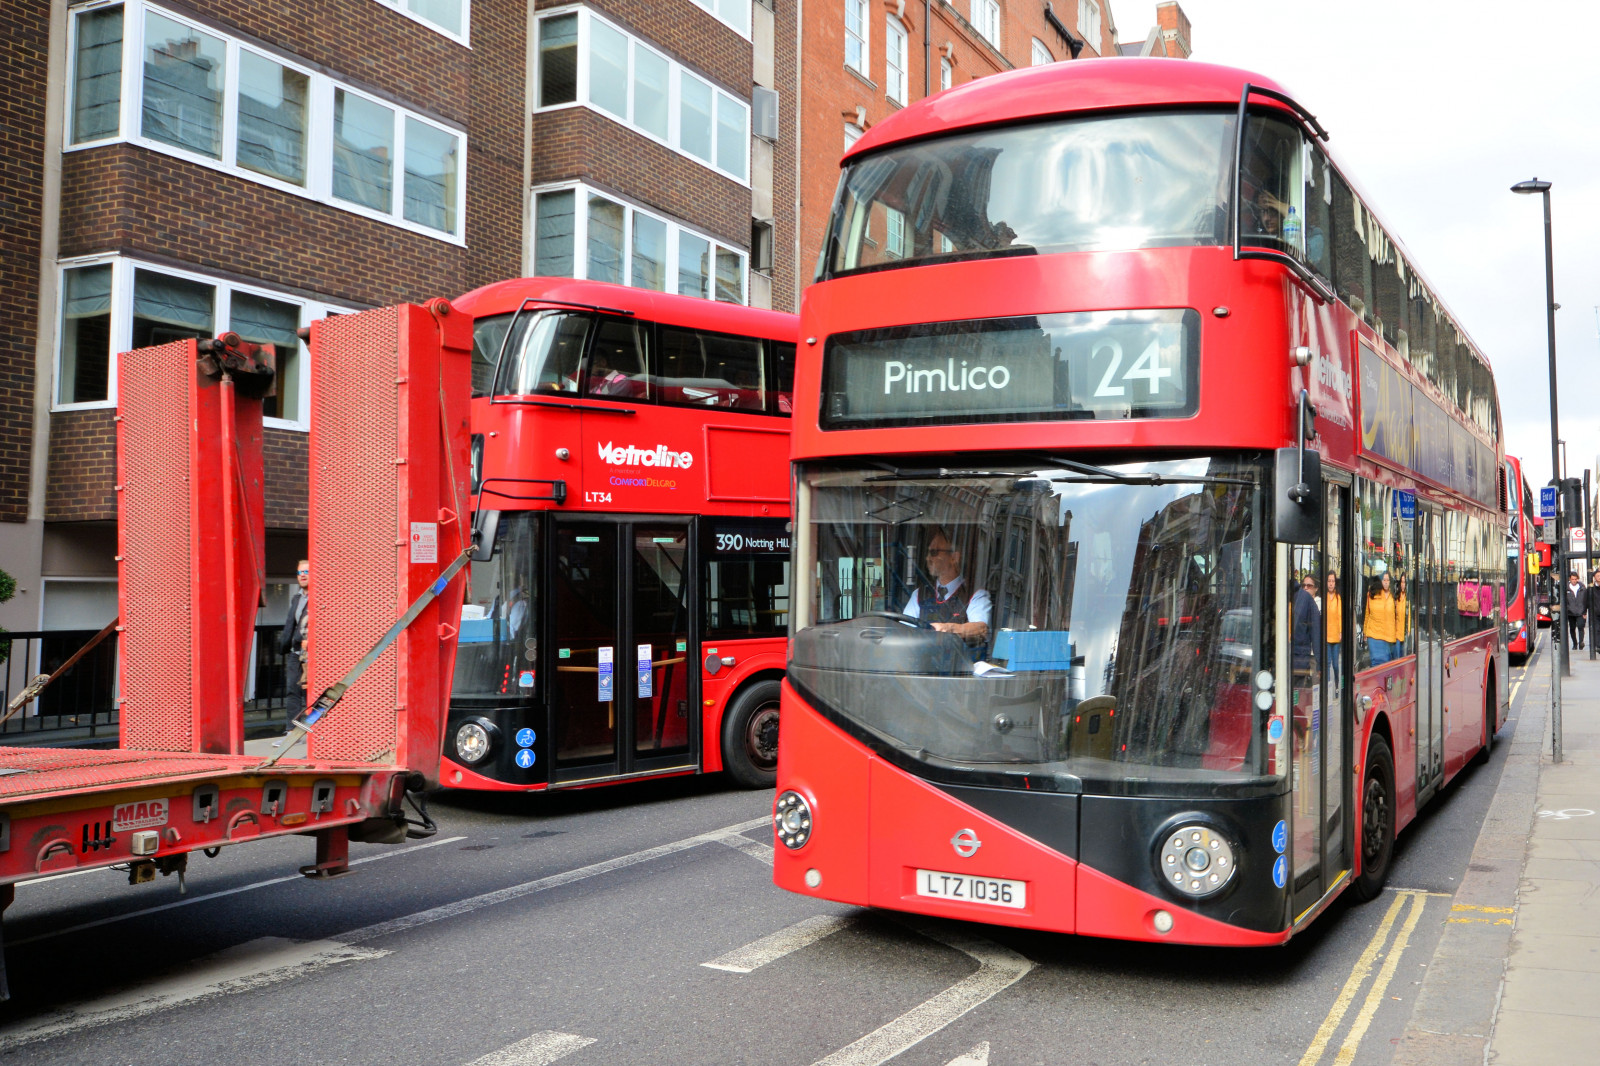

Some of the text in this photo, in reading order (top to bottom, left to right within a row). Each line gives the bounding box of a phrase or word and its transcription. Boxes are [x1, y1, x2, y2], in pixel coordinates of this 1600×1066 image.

[884, 336, 1172, 397] Pimlico 24
[598, 440, 693, 469] Metroline
[585, 491, 612, 503] LT34
[715, 533, 790, 551] 390 Notting Hill
[116, 802, 163, 822] MAC
[927, 873, 1013, 904] LTZ 1036
